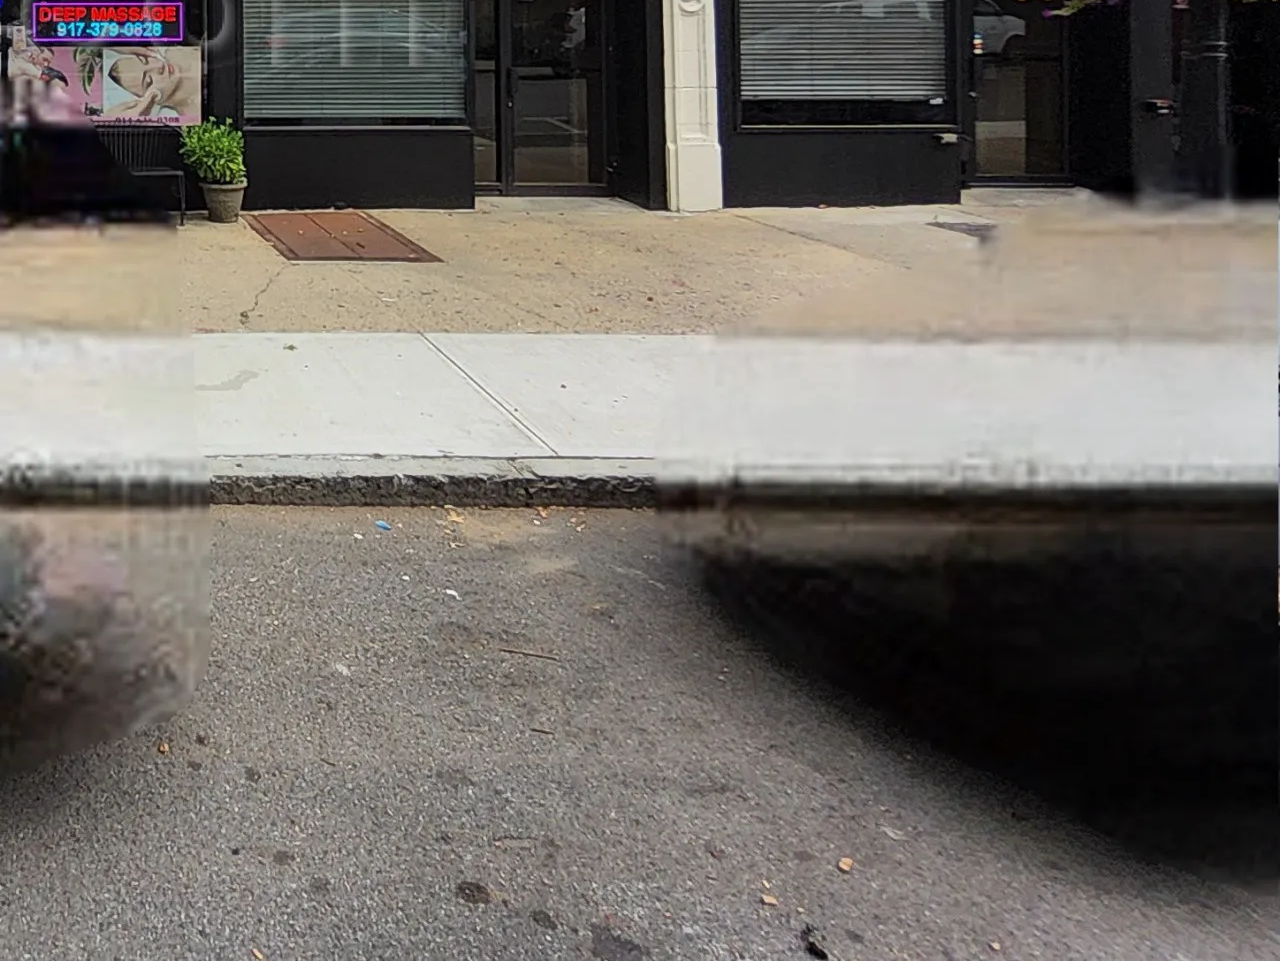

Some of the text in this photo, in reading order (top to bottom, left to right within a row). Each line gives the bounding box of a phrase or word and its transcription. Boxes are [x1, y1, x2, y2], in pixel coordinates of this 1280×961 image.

[38, 6, 177, 22] DEEP MASSAGE
[56, 21, 163, 38] 917-379-0828
